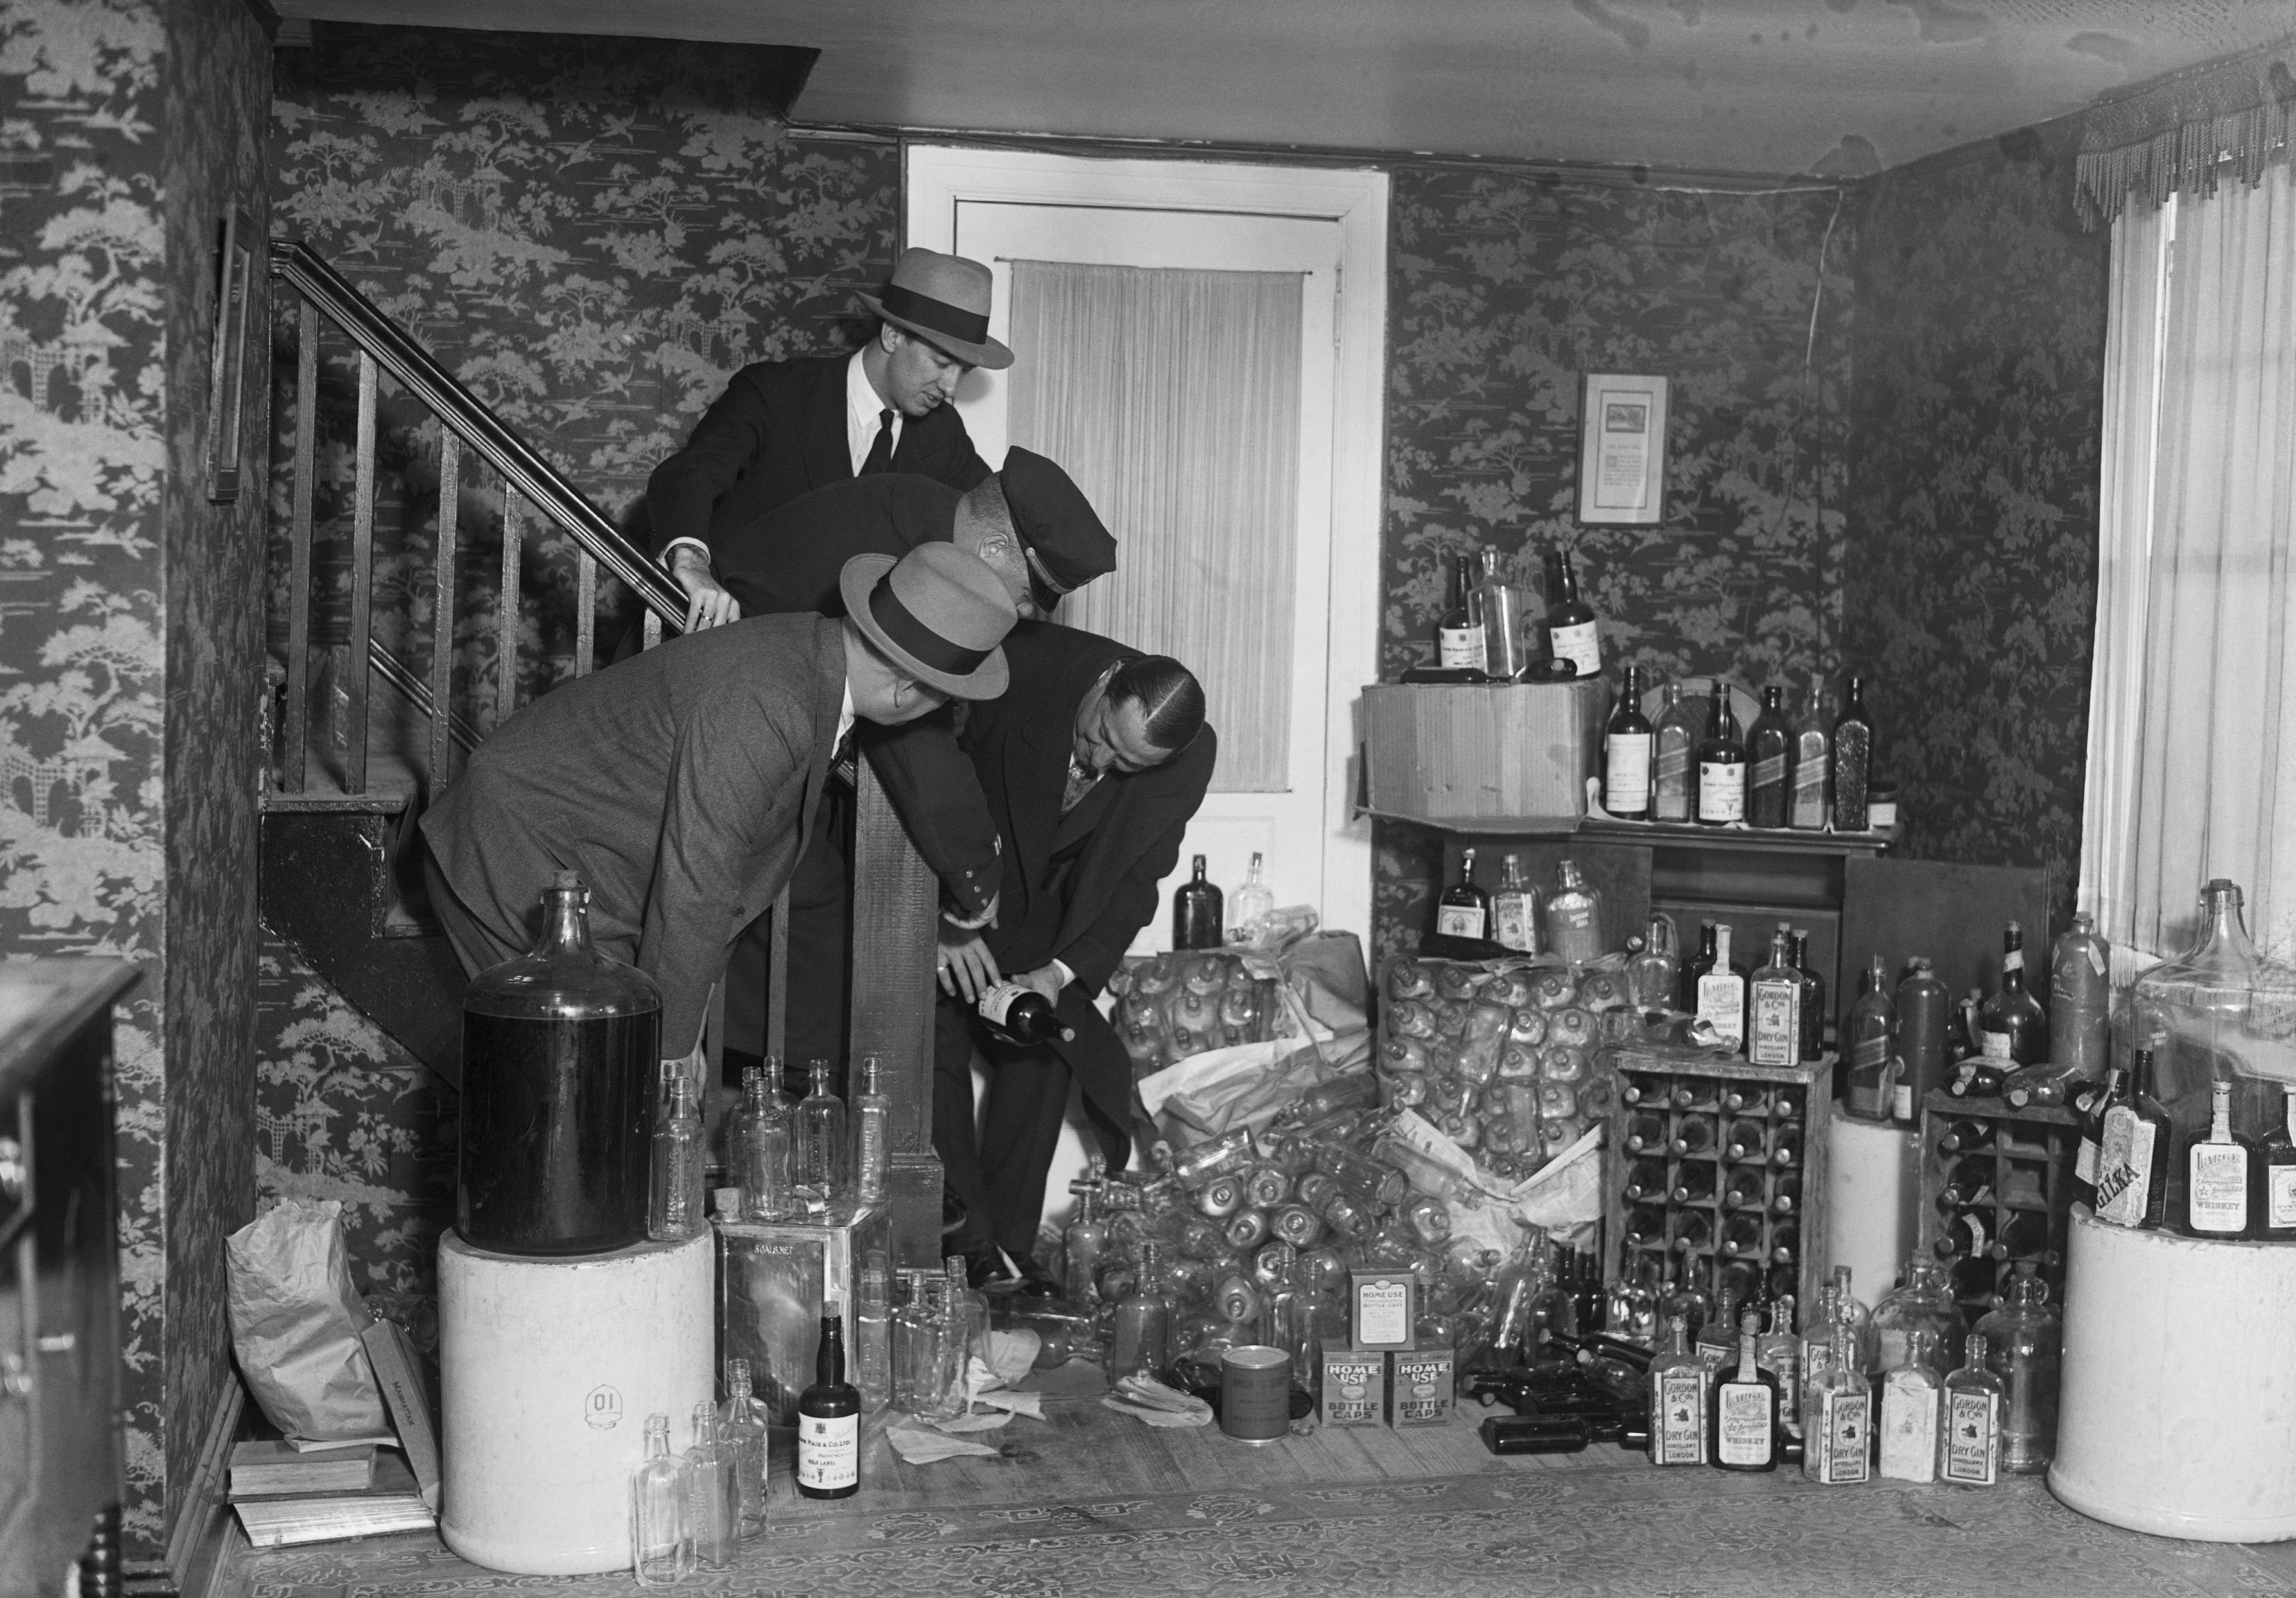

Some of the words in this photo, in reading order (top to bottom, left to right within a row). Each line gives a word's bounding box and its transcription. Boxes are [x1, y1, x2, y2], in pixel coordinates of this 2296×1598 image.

[1758, 1032, 1773, 1042] DRY
[1774, 1032, 1788, 1042] GIN
[2196, 1201, 2240, 1210] WHISKEY
[1329, 1365, 1379, 1374] HOME
[1401, 1363, 1447, 1373] HOME
[1340, 1374, 1368, 1384] USE
[1411, 1372, 1438, 1383] USE
[1665, 1381, 1697, 1395] GORDON
[1328, 1402, 1378, 1411] BOTTLE
[1400, 1400, 1448, 1410] BOTTLE
[1836, 1400, 1865, 1413] GORDON
[1953, 1396, 1987, 1412] GORDON
[1332, 1411, 1373, 1420] CAPS
[1404, 1409, 1443, 1418] CAPS
[1666, 1430, 1682, 1441] DRY
[1684, 1430, 1698, 1441] GIN
[1834, 1448, 1849, 1458] DRY
[1850, 1446, 1863, 1457] GIN
[1952, 1444, 1969, 1456] DRY
[1970, 1445, 1985, 1457] GIN
